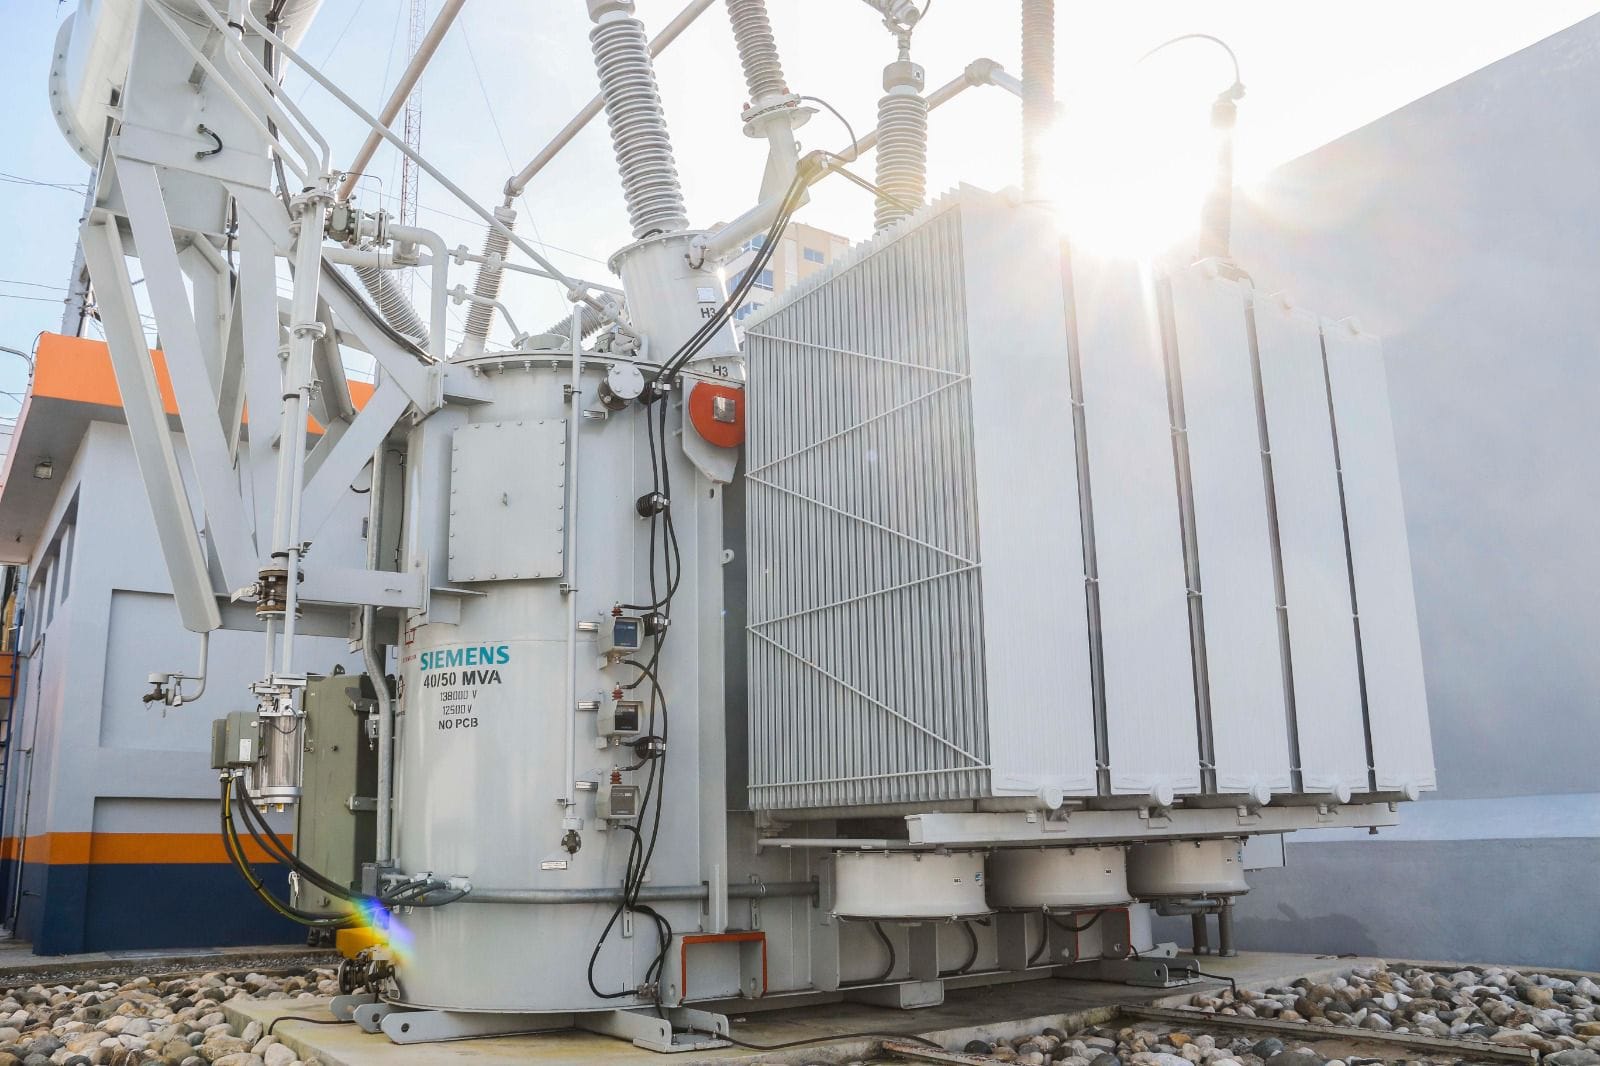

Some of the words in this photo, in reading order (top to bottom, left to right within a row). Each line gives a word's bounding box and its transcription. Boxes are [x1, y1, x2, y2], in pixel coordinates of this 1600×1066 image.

[701, 307, 716, 319] H3
[712, 365, 729, 377] H3
[420, 645, 510, 671] SIEMENS
[423, 672, 457, 688] 40/50
[462, 670, 502, 686] MVA
[472, 690, 478, 699] V
[443, 705, 466, 715] 12500
[467, 704, 472, 713] V
[438, 719, 452, 730] NO
[455, 718, 479, 728] PCB
